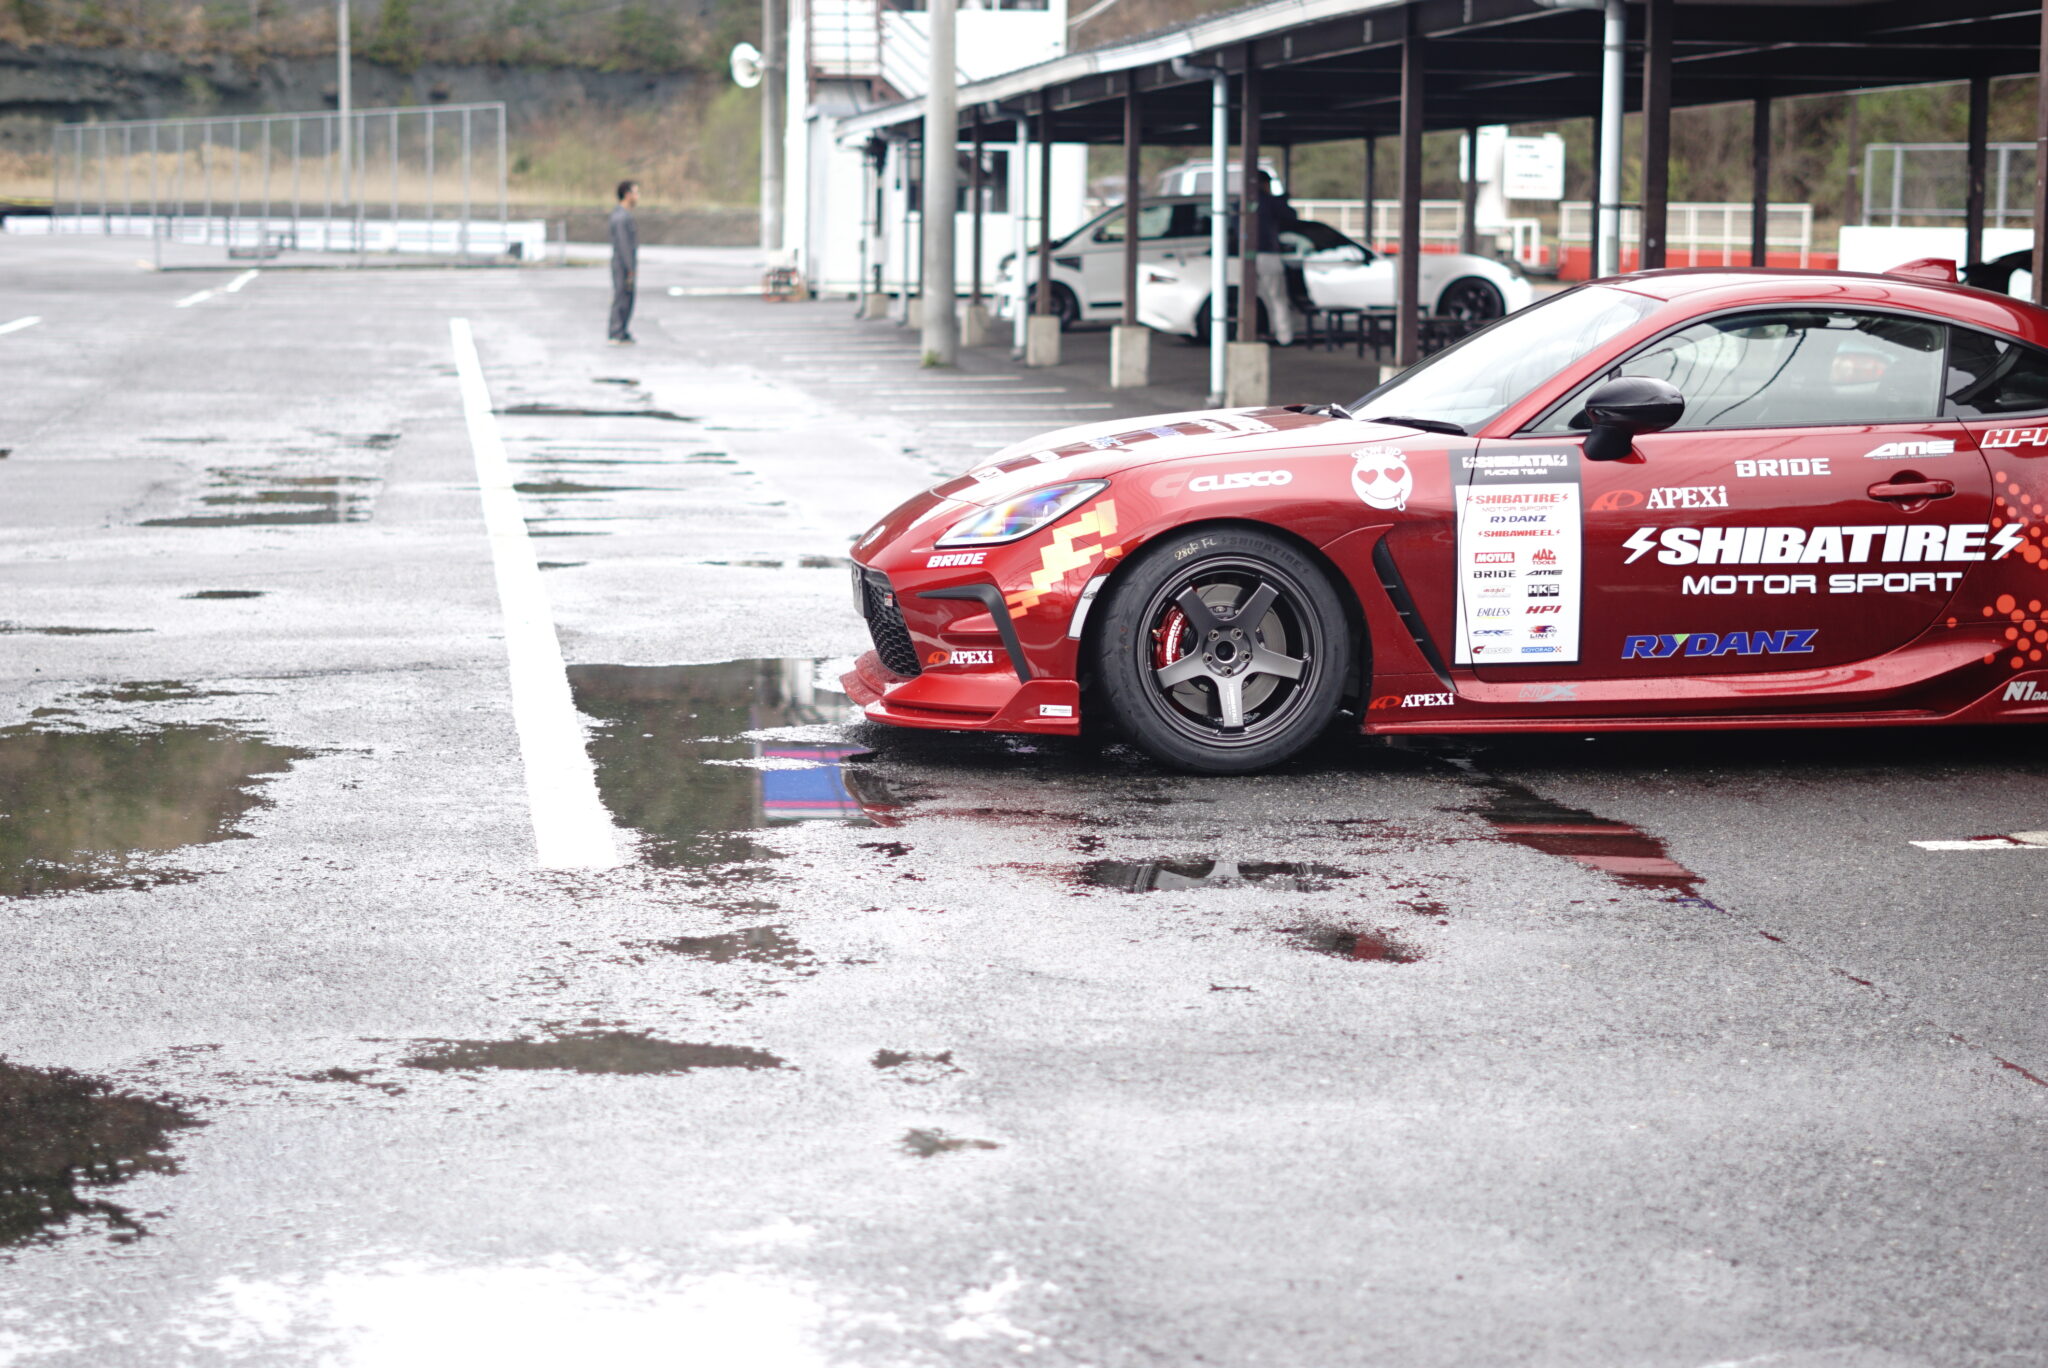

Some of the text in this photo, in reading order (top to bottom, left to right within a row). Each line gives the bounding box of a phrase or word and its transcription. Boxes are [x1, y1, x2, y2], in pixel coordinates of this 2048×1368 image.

[1864, 440, 1956, 457] AME
[1735, 458, 1831, 477] BRIDE
[1188, 469, 1293, 492] CUSCO
[1475, 493, 1561, 504] SHIBATIRE
[1483, 529, 1555, 537] SHIBAWHEEL
[1657, 524, 1989, 565] SHIBATIRE
[926, 552, 987, 568] BRIDE
[1475, 553, 1514, 562] MOTUL
[1532, 548, 1556, 560] MAC
[1473, 570, 1516, 578] BRIDE
[1528, 584, 1559, 596] HKS
[1682, 572, 1963, 595] MOTOR SPORT
[1477, 608, 1511, 616] ENDLESS
[1525, 605, 1562, 614] HPI
[1621, 629, 1819, 659] RYDANZ
[2002, 681, 2038, 701] N1
